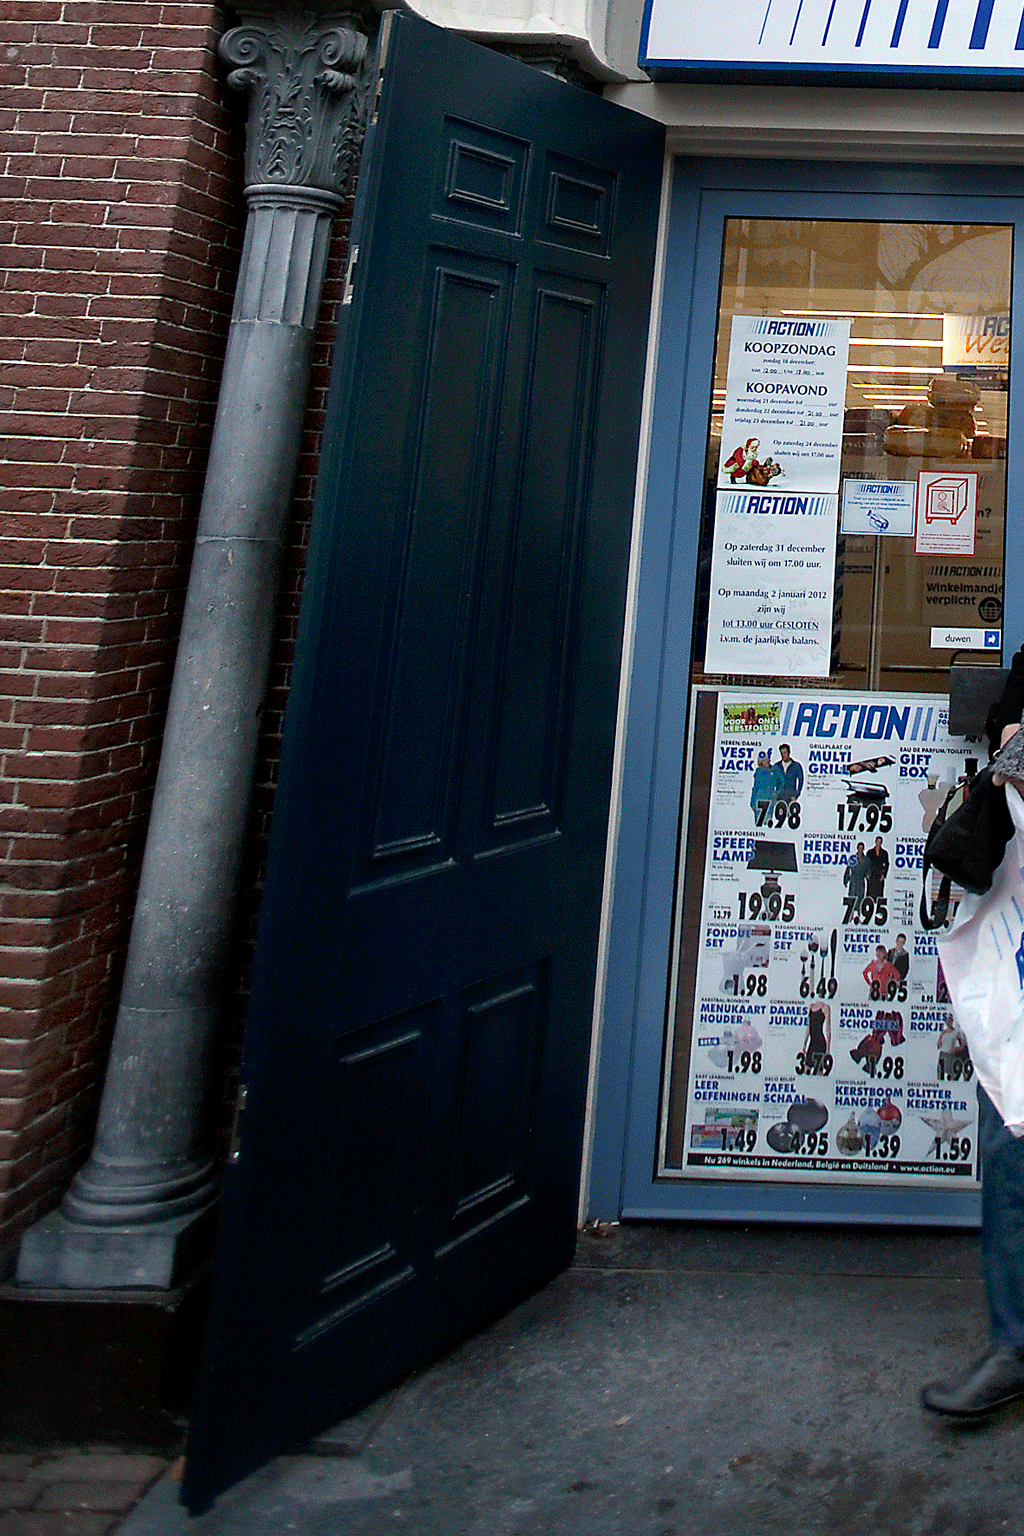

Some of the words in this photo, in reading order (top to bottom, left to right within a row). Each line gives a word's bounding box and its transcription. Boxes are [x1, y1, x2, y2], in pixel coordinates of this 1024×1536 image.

[767, 320, 816, 337] ACTION
[744, 342, 837, 357] KOOPZONDAG
[746, 382, 828, 397] KOOPAVOND
[866, 484, 893, 494] ACTION
[746, 495, 809, 515] ACTION
[724, 542, 738, 553] Op
[739, 542, 774, 553] zaterdag
[774, 544, 785, 552] 31
[786, 543, 826, 554] december
[726, 557, 752, 567] sluiten
[753, 559, 767, 569] wij
[784, 559, 805, 568] 17.00
[805, 561, 822, 569] uur.
[717, 587, 731, 599] Op
[732, 588, 769, 600] maandag
[770, 590, 777, 598] 2
[777, 589, 806, 600] januari
[807, 591, 828, 600] 2012
[925, 594, 977, 606] verplicht
[756, 605, 772, 615] zijn
[772, 605, 787, 615] wij
[722, 619, 734, 628] tot
[735, 619, 758, 629] 13.00
[758, 621, 774, 629] uur
[774, 620, 819, 630] GESLOTEN
[719, 634, 741, 643] i.v.m.
[742, 634, 754, 643] de
[754, 635, 790, 645] jaarlijkse
[791, 636, 820, 646] balans.
[944, 634, 972, 643] duwen
[724, 718, 747, 726] VOOR
[757, 717, 779, 725] ONZE
[793, 702, 912, 741] ACTION
[724, 724, 780, 733] KERSTFOLDER
[720, 746, 755, 759] VEST
[757, 747, 774, 759] of
[899, 746, 909, 754] EAU
[808, 750, 852, 763] MULTI
[899, 753, 931, 765] GIFT
[719, 759, 755, 771] JACK
[808, 763, 850, 775] GRILL
[899, 766, 929, 778] BOX
[755, 800, 801, 830] 7.98
[837, 803, 893, 834] 17.95
[713, 829, 734, 837] SILVER
[734, 830, 767, 838] PORSELEIN
[713, 837, 756, 850] SFEER
[803, 839, 851, 853] HEREN
[895, 843, 924, 856] DEK
[712, 850, 754, 863] LAMP
[803, 852, 858, 866] BADJAS
[895, 856, 924, 869] OVE
[738, 892, 796, 923] 19.95
[841, 896, 889, 927] 7.95
[713, 909, 732, 920] 13.79
[706, 928, 752, 939] FONDUE
[775, 930, 814, 941] BESTEK
[844, 933, 881, 944] FLEECE
[705, 938, 725, 948] SET
[773, 941, 793, 951] SET
[843, 943, 870, 954] VEST
[732, 973, 768, 997] 1.98
[799, 976, 838, 1000] 6.49
[870, 980, 909, 1003] 8.95
[700, 1003, 767, 1015] MENUKAART
[769, 1005, 809, 1016] DAMES
[840, 1007, 873, 1019] HAND
[700, 1013, 744, 1025] HOUDER
[768, 1016, 810, 1027] JURKJE
[910, 1011, 948, 1022] DAMES
[839, 1018, 900, 1031] SCHOENEN
[910, 1021, 946, 1033] ROKJE
[726, 1049, 763, 1074] 1.98
[795, 1052, 834, 1076] 3.79
[868, 1055, 905, 1080] 1.98
[937, 1058, 974, 1082] 1.99
[694, 1080, 719, 1090] LEER
[764, 1083, 797, 1093] TAFEL
[835, 1085, 904, 1097] KERSTBOOM
[694, 1090, 760, 1102] OEFENINGEN
[763, 1093, 806, 1104] SCHAAL
[907, 1087, 952, 1099] GLITTER
[835, 1096, 888, 1108] HANGERS
[906, 1098, 968, 1111] KERSTSTER
[720, 1127, 757, 1152] 1.49
[790, 1131, 829, 1156] 4.95
[864, 1133, 901, 1159] 1.39
[934, 1136, 972, 1162] 1.59
[704, 1155, 717, 1164] Nu
[717, 1156, 732, 1164] 269
[733, 1157, 761, 1167] winkels
[762, 1158, 771, 1167] in
[771, 1158, 814, 1169] Nederland,
[852, 1162, 890, 1172] Duitsland
[900, 1164, 956, 1174] www.action.eu
